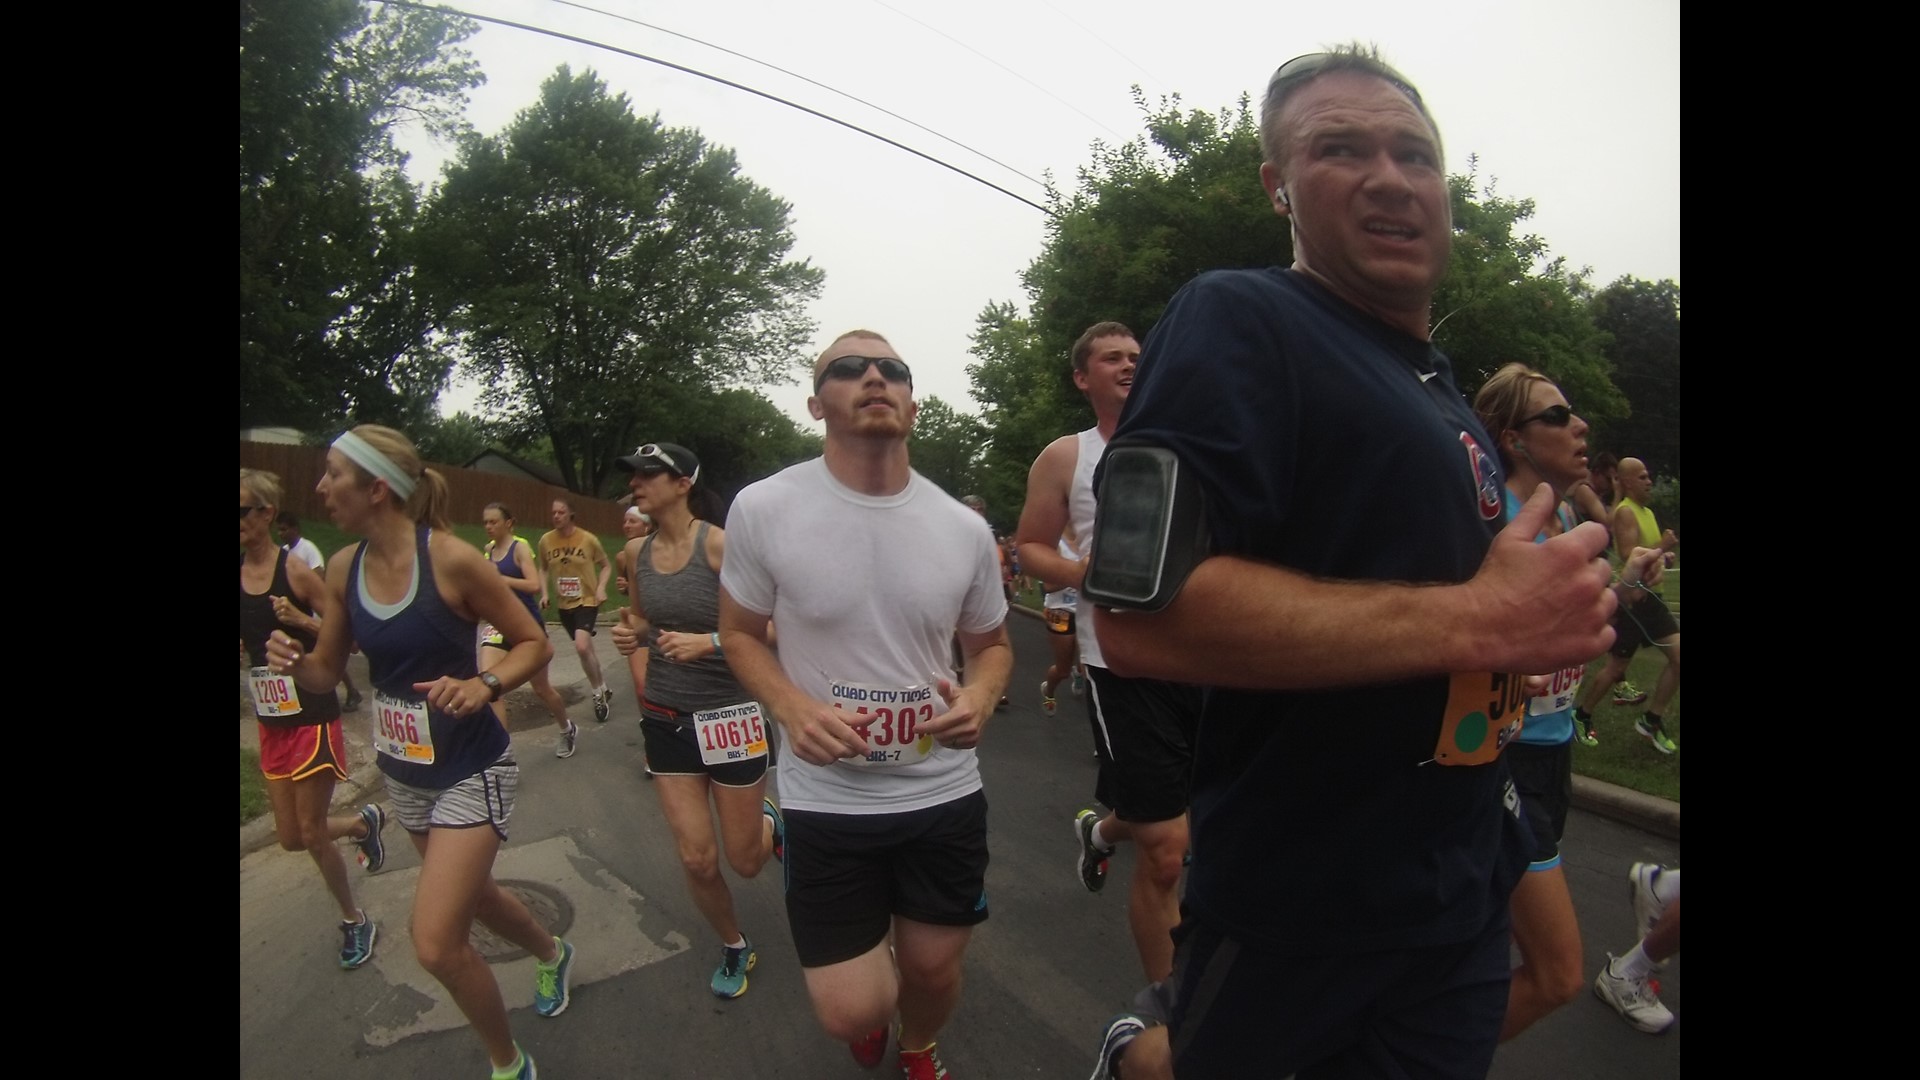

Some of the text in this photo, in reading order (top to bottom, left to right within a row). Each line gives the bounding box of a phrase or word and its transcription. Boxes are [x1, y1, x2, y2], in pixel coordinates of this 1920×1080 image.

[547, 547, 586, 561] IOWA
[255, 679, 288, 703] 1209
[832, 685, 932, 703] QUAD CITY TIMES
[698, 705, 758, 722] QUAD CITY TIMES
[378, 707, 419, 745] 1966
[702, 716, 764, 751] 10615
